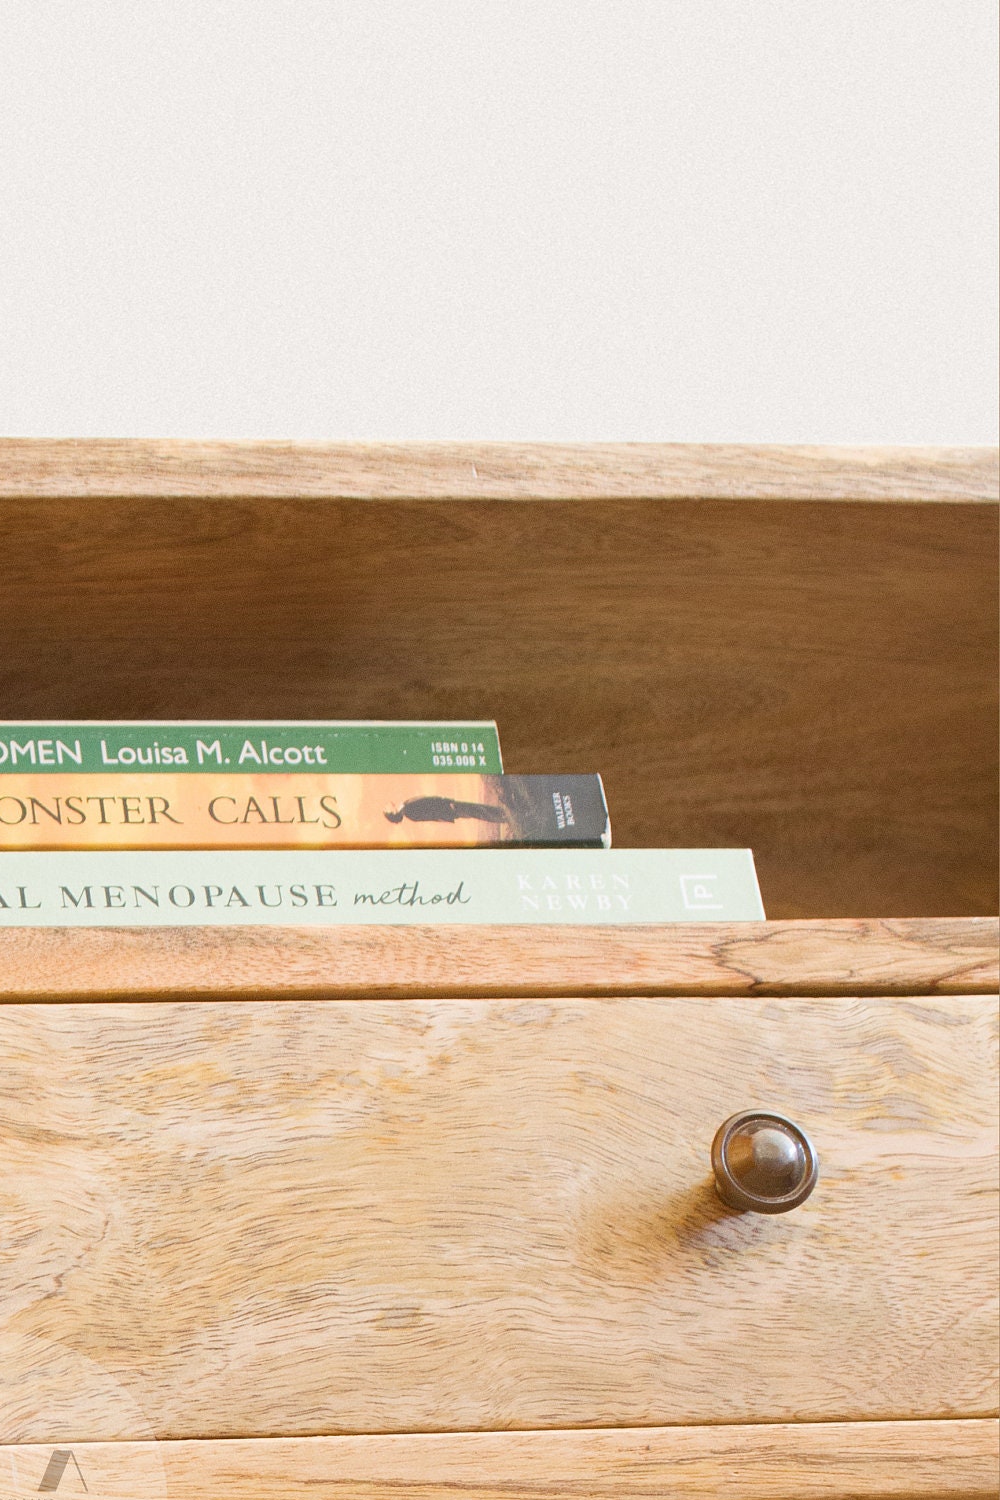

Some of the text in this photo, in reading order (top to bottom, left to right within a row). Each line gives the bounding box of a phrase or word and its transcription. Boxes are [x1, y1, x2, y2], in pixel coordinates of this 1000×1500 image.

[100, 740, 190, 766] Louisa
[196, 740, 231, 766] M.
[237, 740, 328, 766] Alcott
[431, 742, 459, 753] ISBN
[472, 742, 484, 753] 14
[479, 756, 486, 766] X
[208, 796, 342, 829] CALLS
[552, 792, 566, 829] WALKER
[563, 795, 575, 826] BOOKS
[516, 874, 630, 890] KAREN
[60, 885, 337, 910] MENOPAUSE
[353, 881, 472, 908] method
[521, 894, 633, 911] NEWBY
